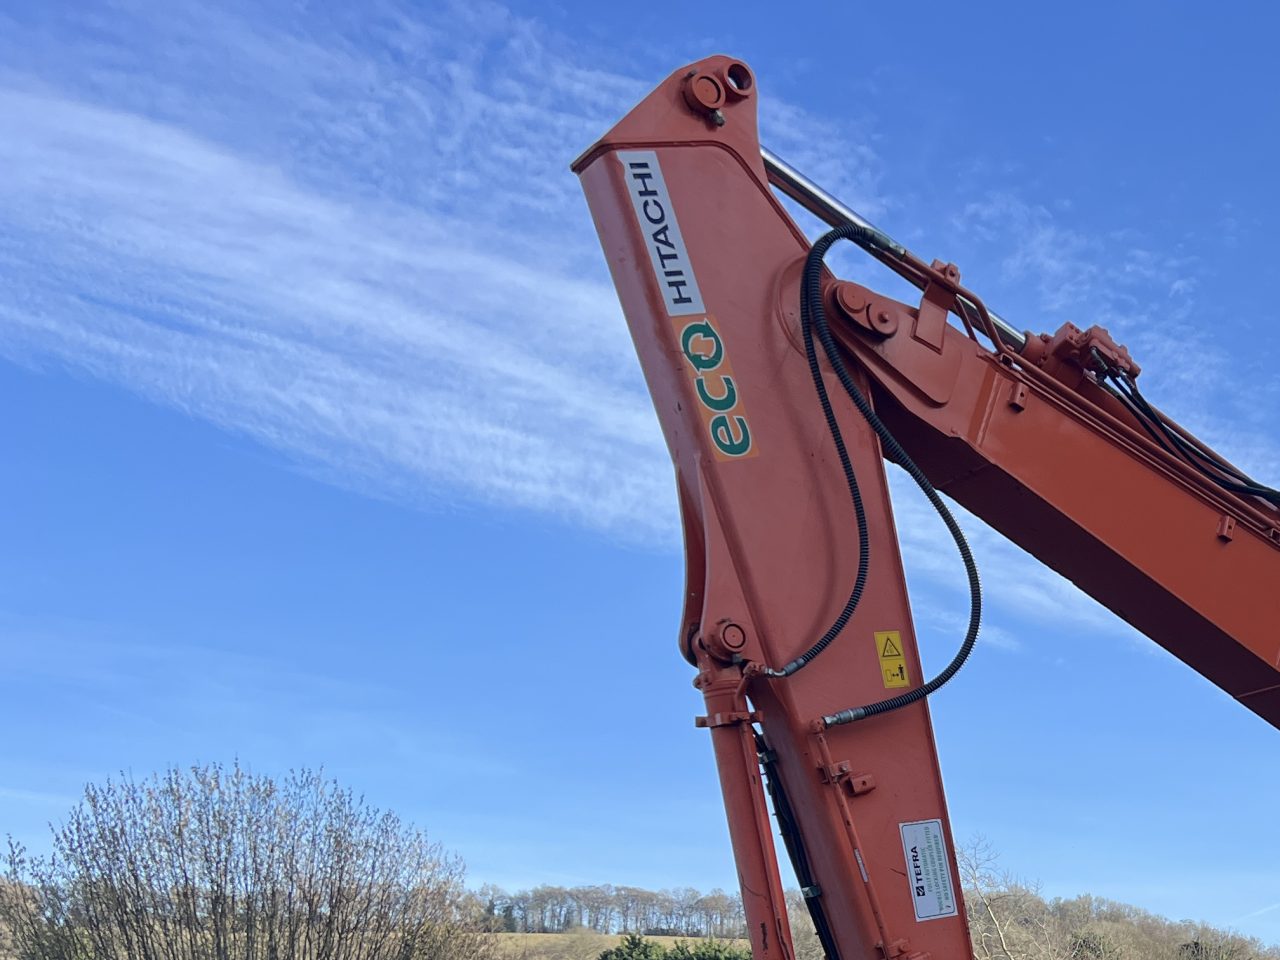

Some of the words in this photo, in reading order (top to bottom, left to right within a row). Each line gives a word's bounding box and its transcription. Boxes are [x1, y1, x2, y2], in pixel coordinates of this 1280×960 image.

[628, 162, 692, 304] HITACHI
[910, 846, 923, 884] TEFRA
[920, 847, 930, 876] AUTOMATIC
